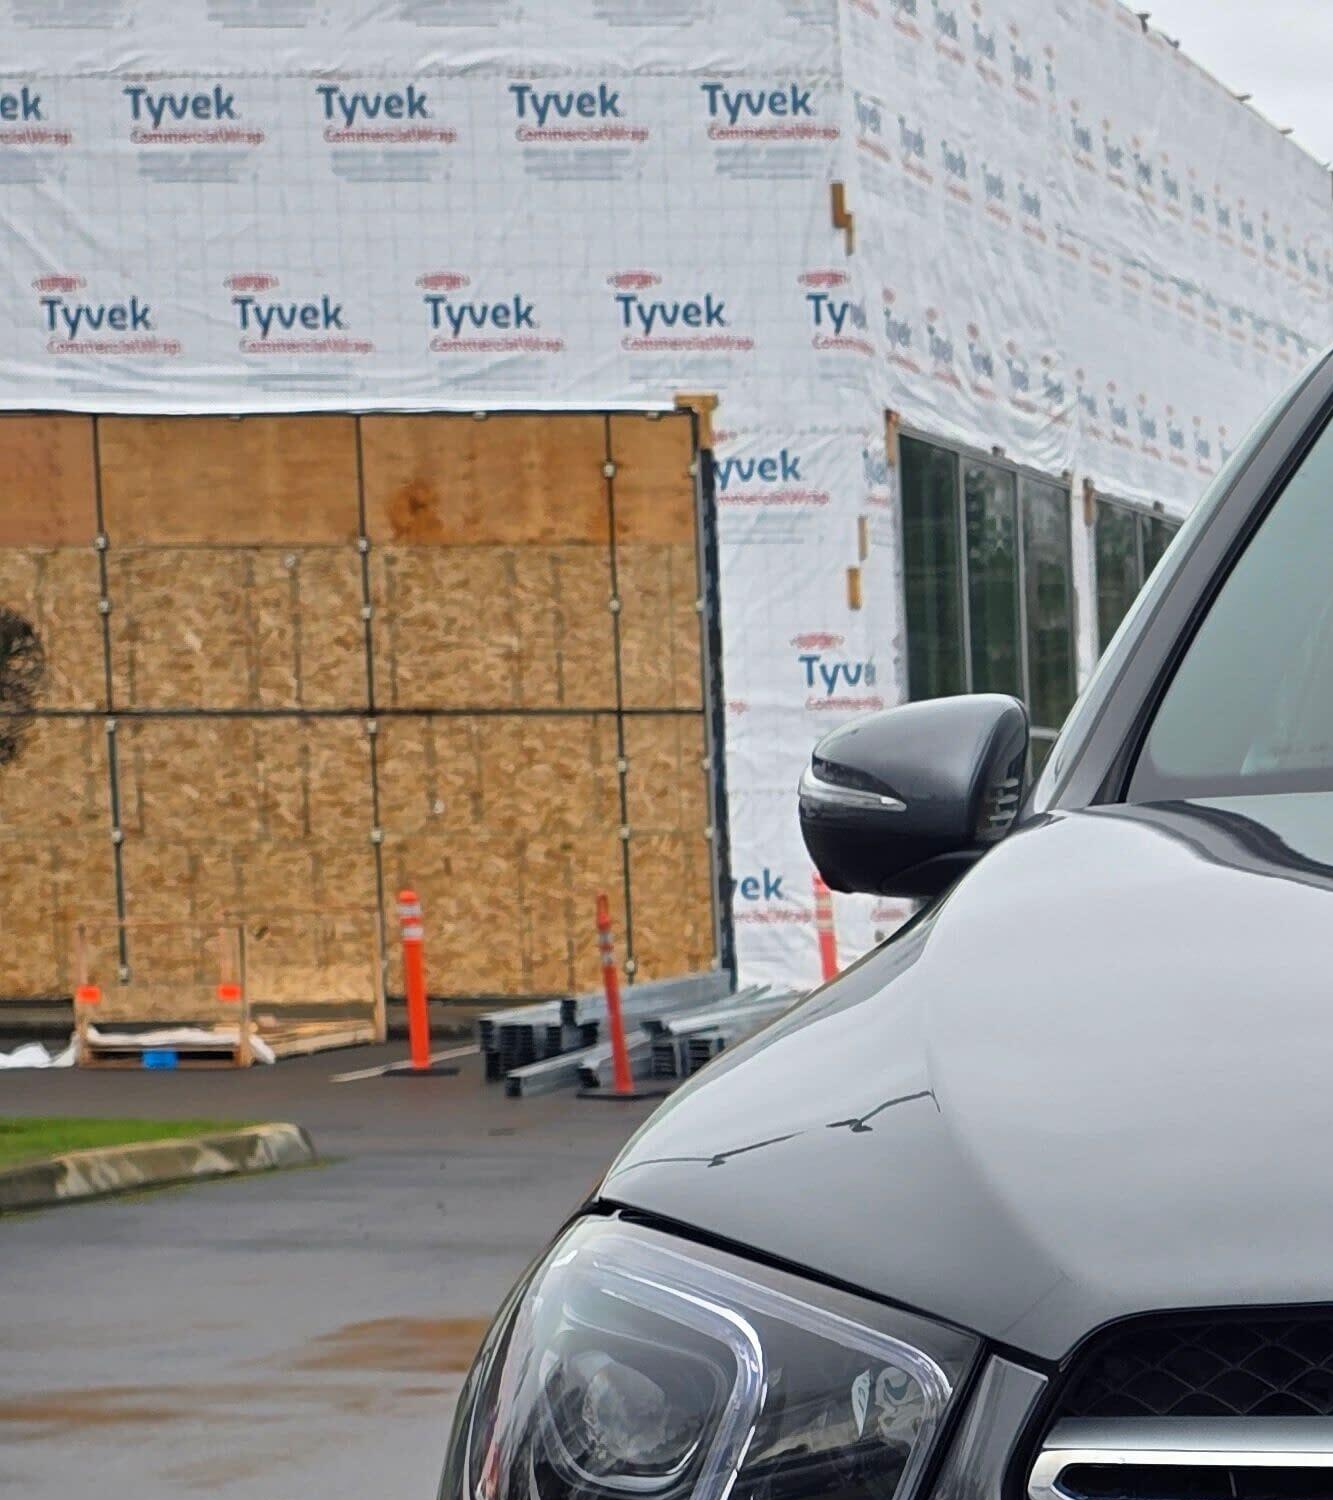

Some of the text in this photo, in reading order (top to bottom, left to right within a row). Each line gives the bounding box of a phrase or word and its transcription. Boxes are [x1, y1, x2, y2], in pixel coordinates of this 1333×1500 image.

[123, 84, 237, 128] Tyvek
[315, 83, 428, 127] Tyvek
[508, 82, 621, 126] Tyvek
[700, 81, 814, 125] Tyvek
[40, 295, 151, 339] Tyvek
[231, 294, 344, 338] Tyvek
[424, 293, 535, 337] Tyvek
[615, 292, 727, 335] Tyvek
